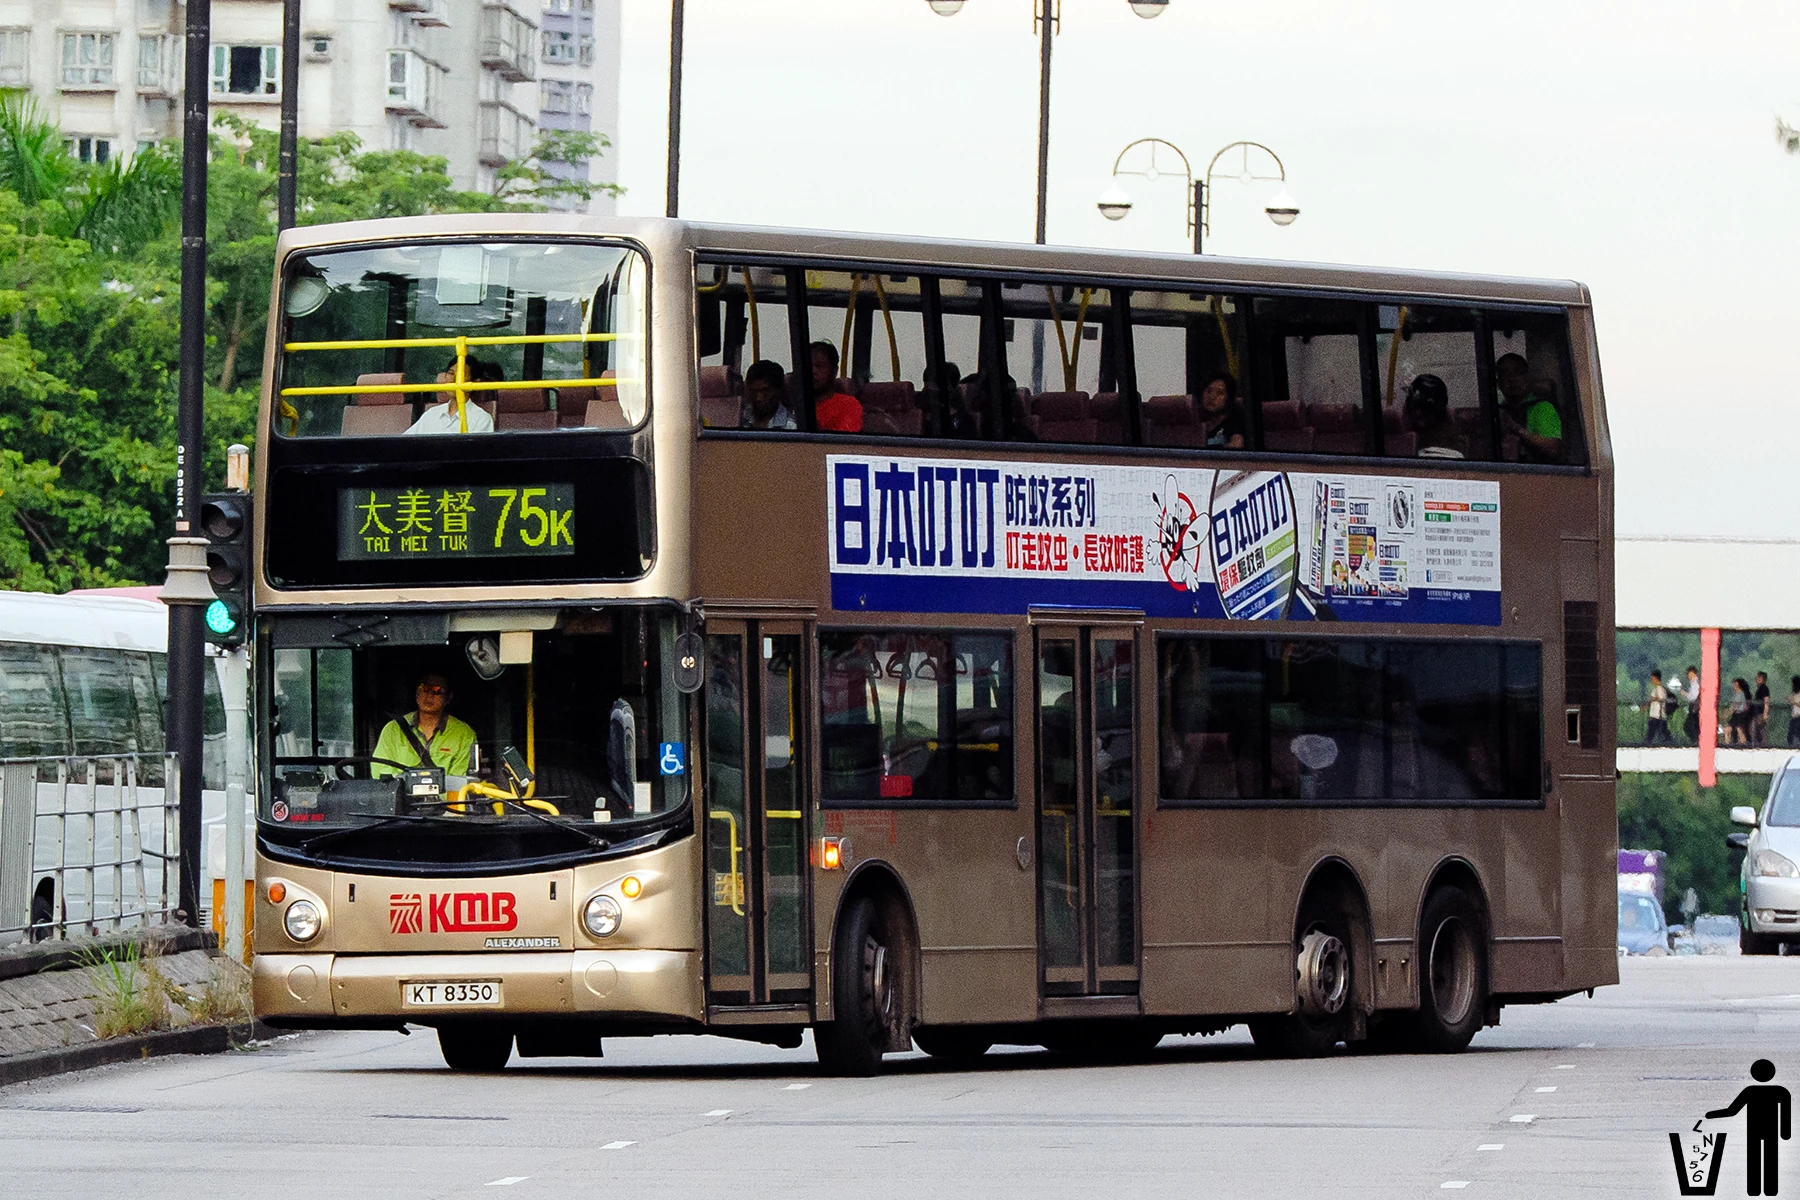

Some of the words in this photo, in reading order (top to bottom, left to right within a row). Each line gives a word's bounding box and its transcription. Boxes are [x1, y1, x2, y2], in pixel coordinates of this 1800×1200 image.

[354, 489, 476, 535] 大美督
[488, 487, 574, 549] 75K
[833, 461, 1000, 569] 日本叮叮
[1004, 473, 1096, 529] 防蚊系列
[1211, 473, 1289, 567] 日本叮叮
[363, 537, 391, 553] TAI
[400, 536, 428, 552] MEI
[438, 535, 468, 551] TUK
[485, 938, 561, 949] ALEXANDER
[413, 985, 438, 1003] KT
[444, 984, 494, 1002] 8350
